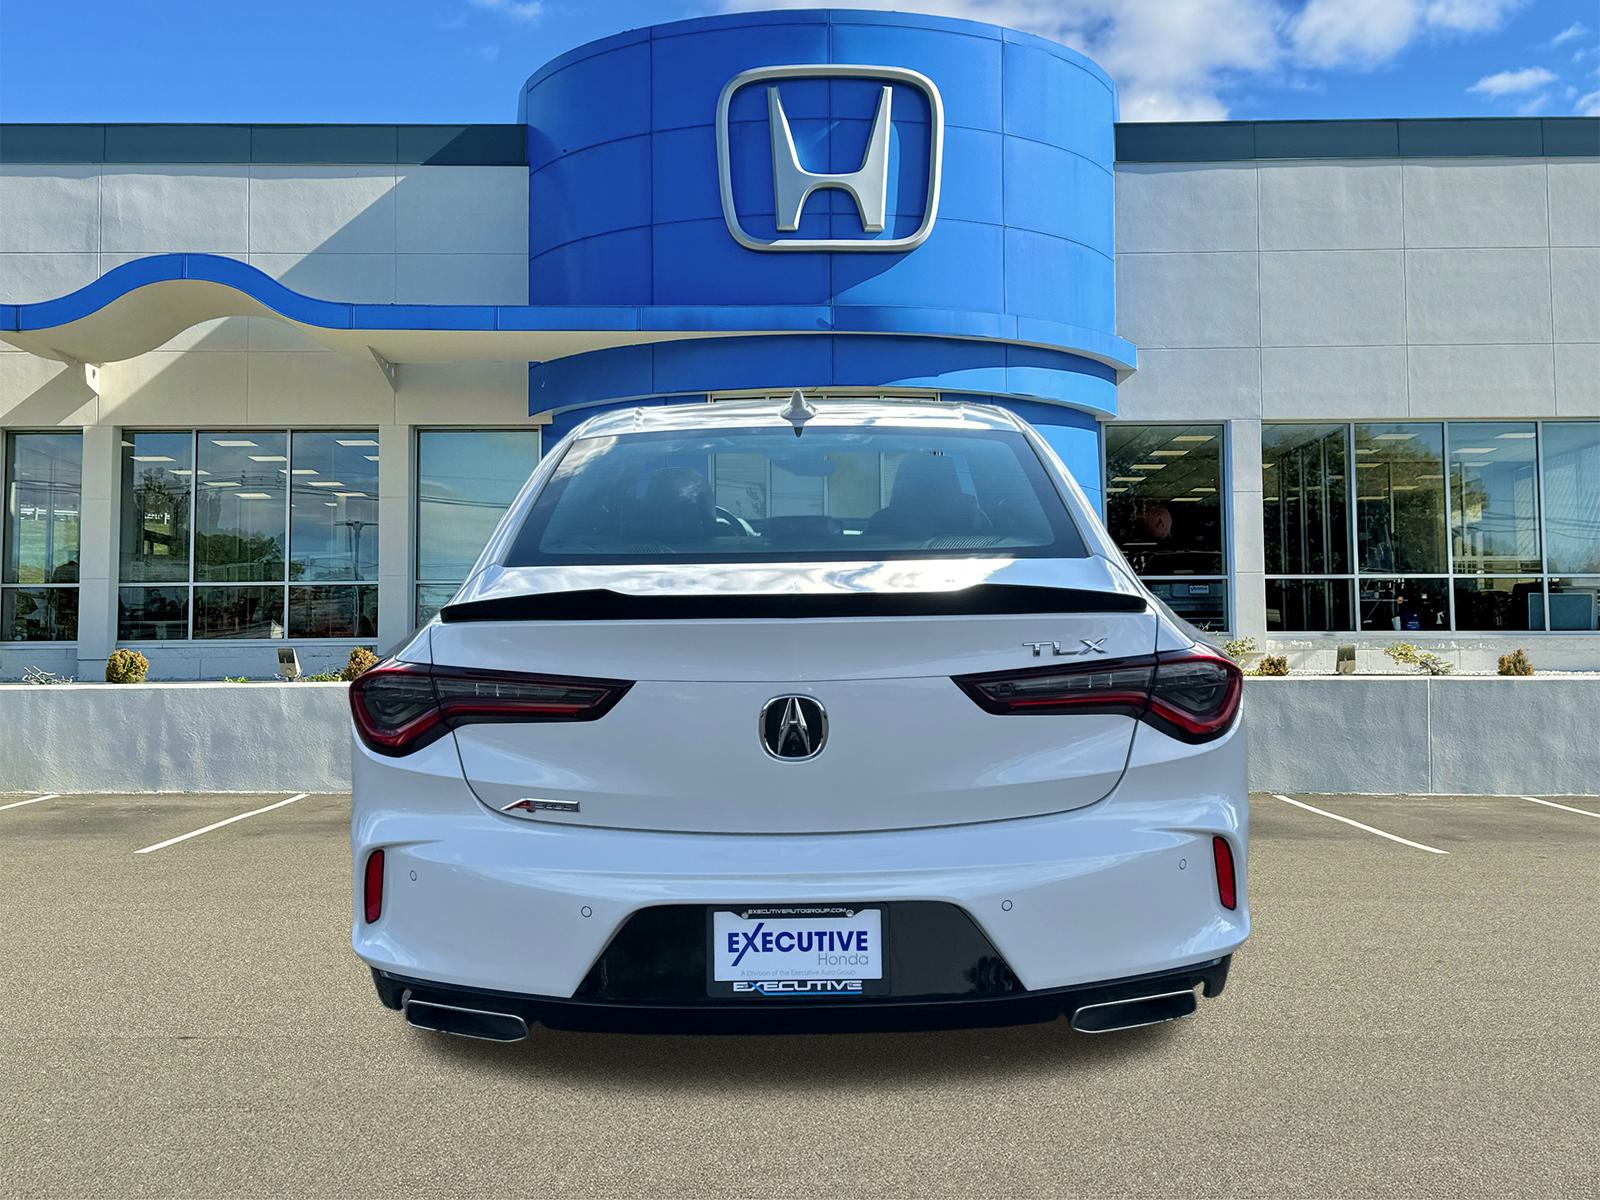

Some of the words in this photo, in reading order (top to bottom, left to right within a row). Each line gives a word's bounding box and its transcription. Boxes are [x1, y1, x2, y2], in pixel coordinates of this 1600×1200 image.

[1022, 637, 1109, 657] TLX
[728, 922, 868, 966] EXECUTIVE
[818, 953, 869, 966] Honda
[733, 980, 863, 994] EXECUTIVE
